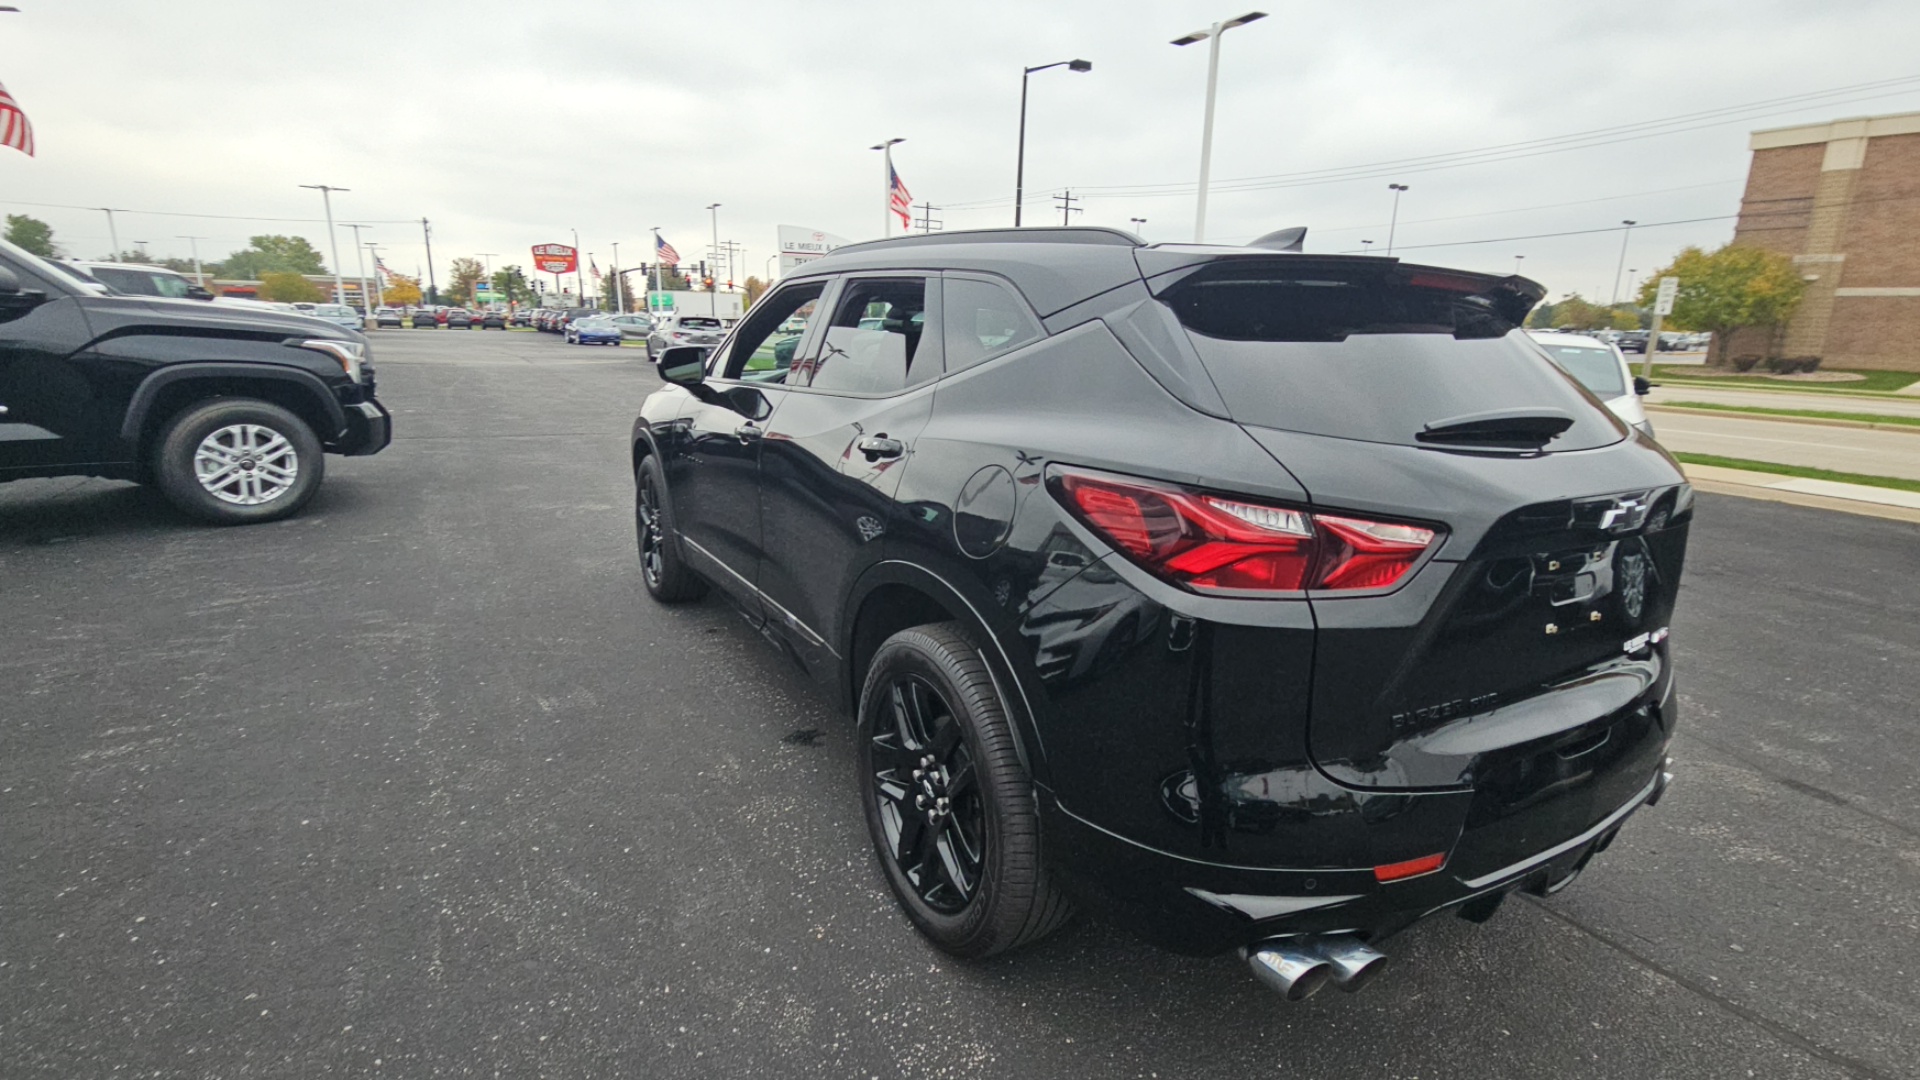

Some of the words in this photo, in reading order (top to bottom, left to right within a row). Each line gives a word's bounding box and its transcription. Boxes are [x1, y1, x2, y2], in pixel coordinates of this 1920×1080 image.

[534, 246, 545, 255] LE
[784, 242, 794, 250] LE
[798, 242, 823, 251] MIEUX
